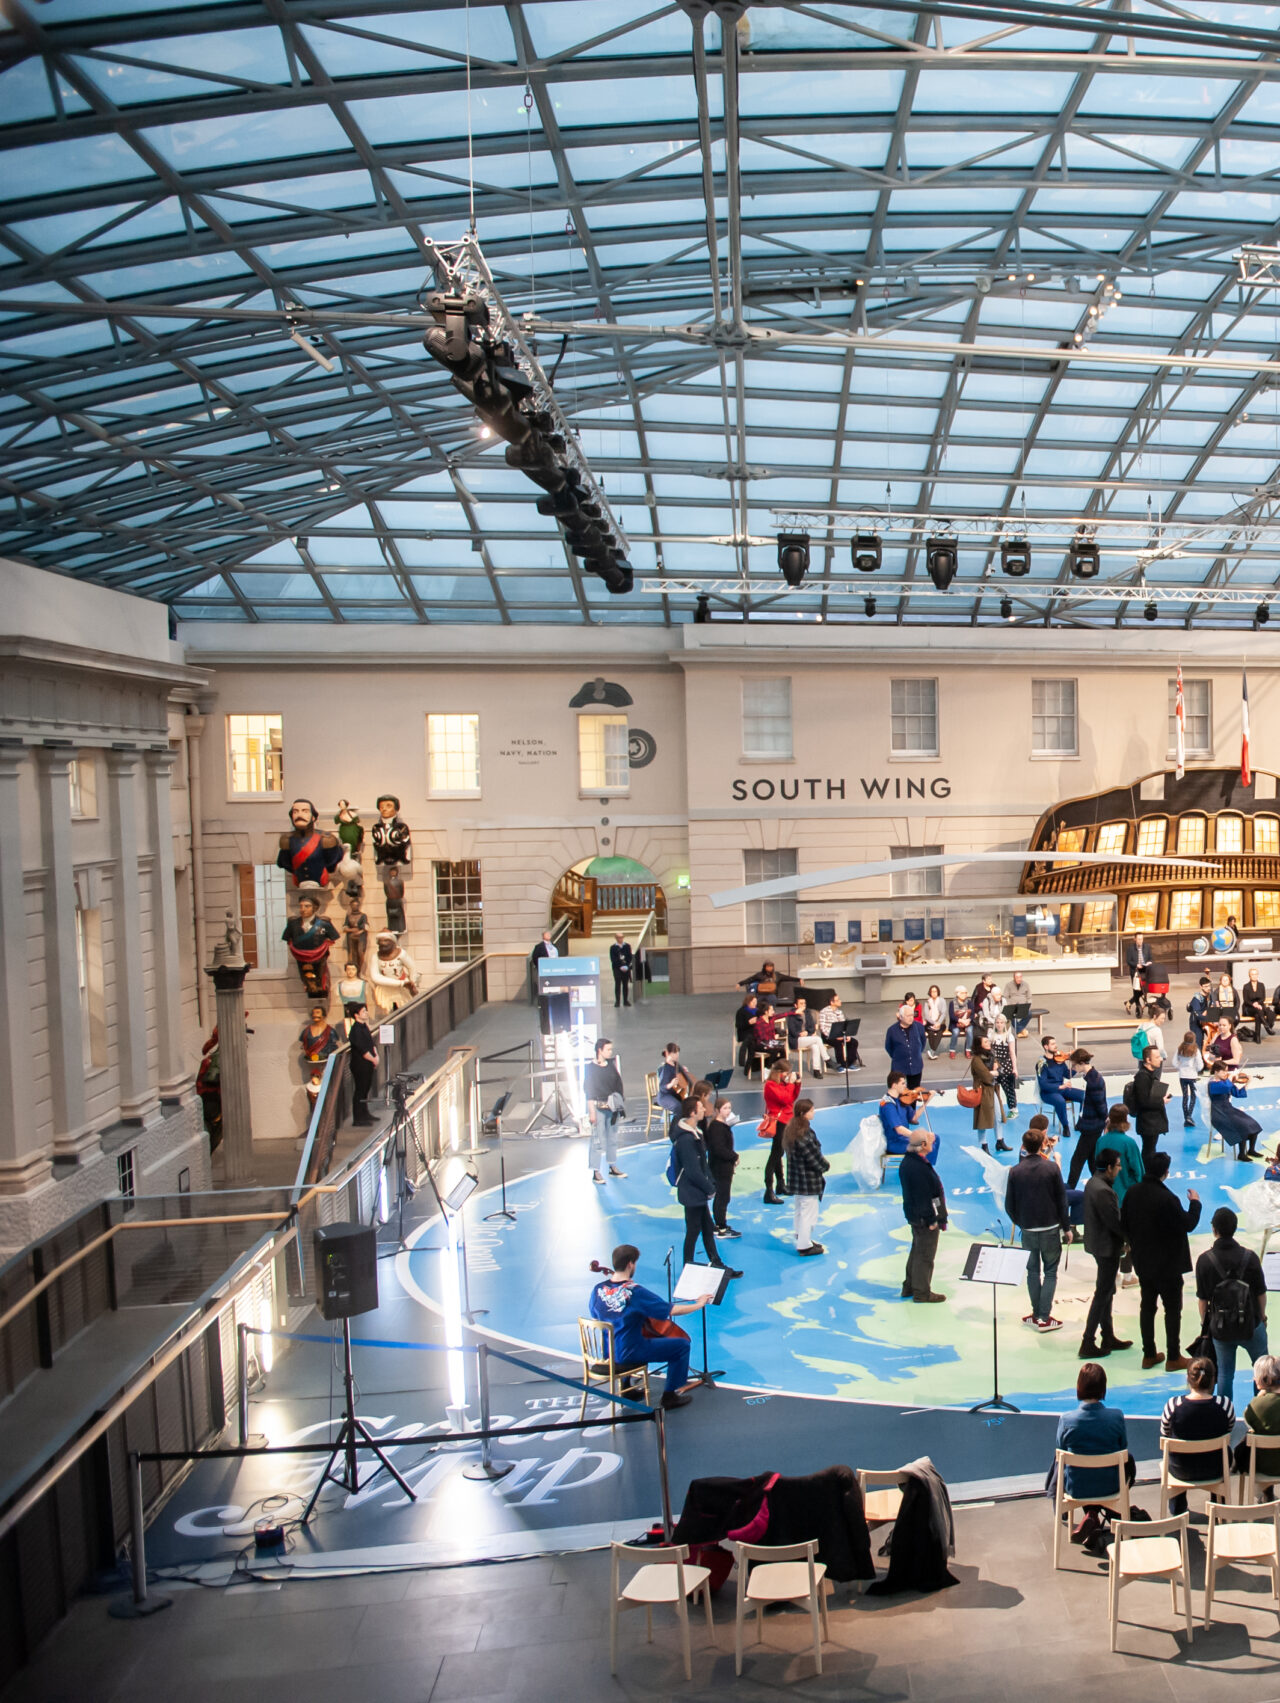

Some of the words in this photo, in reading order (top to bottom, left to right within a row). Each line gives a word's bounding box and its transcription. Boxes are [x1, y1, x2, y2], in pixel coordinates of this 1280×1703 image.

[732, 778, 845, 801] SOUTH
[859, 777, 952, 799] WING
[589, 960, 596, 972] 1
[524, 1393, 602, 1411] THE
